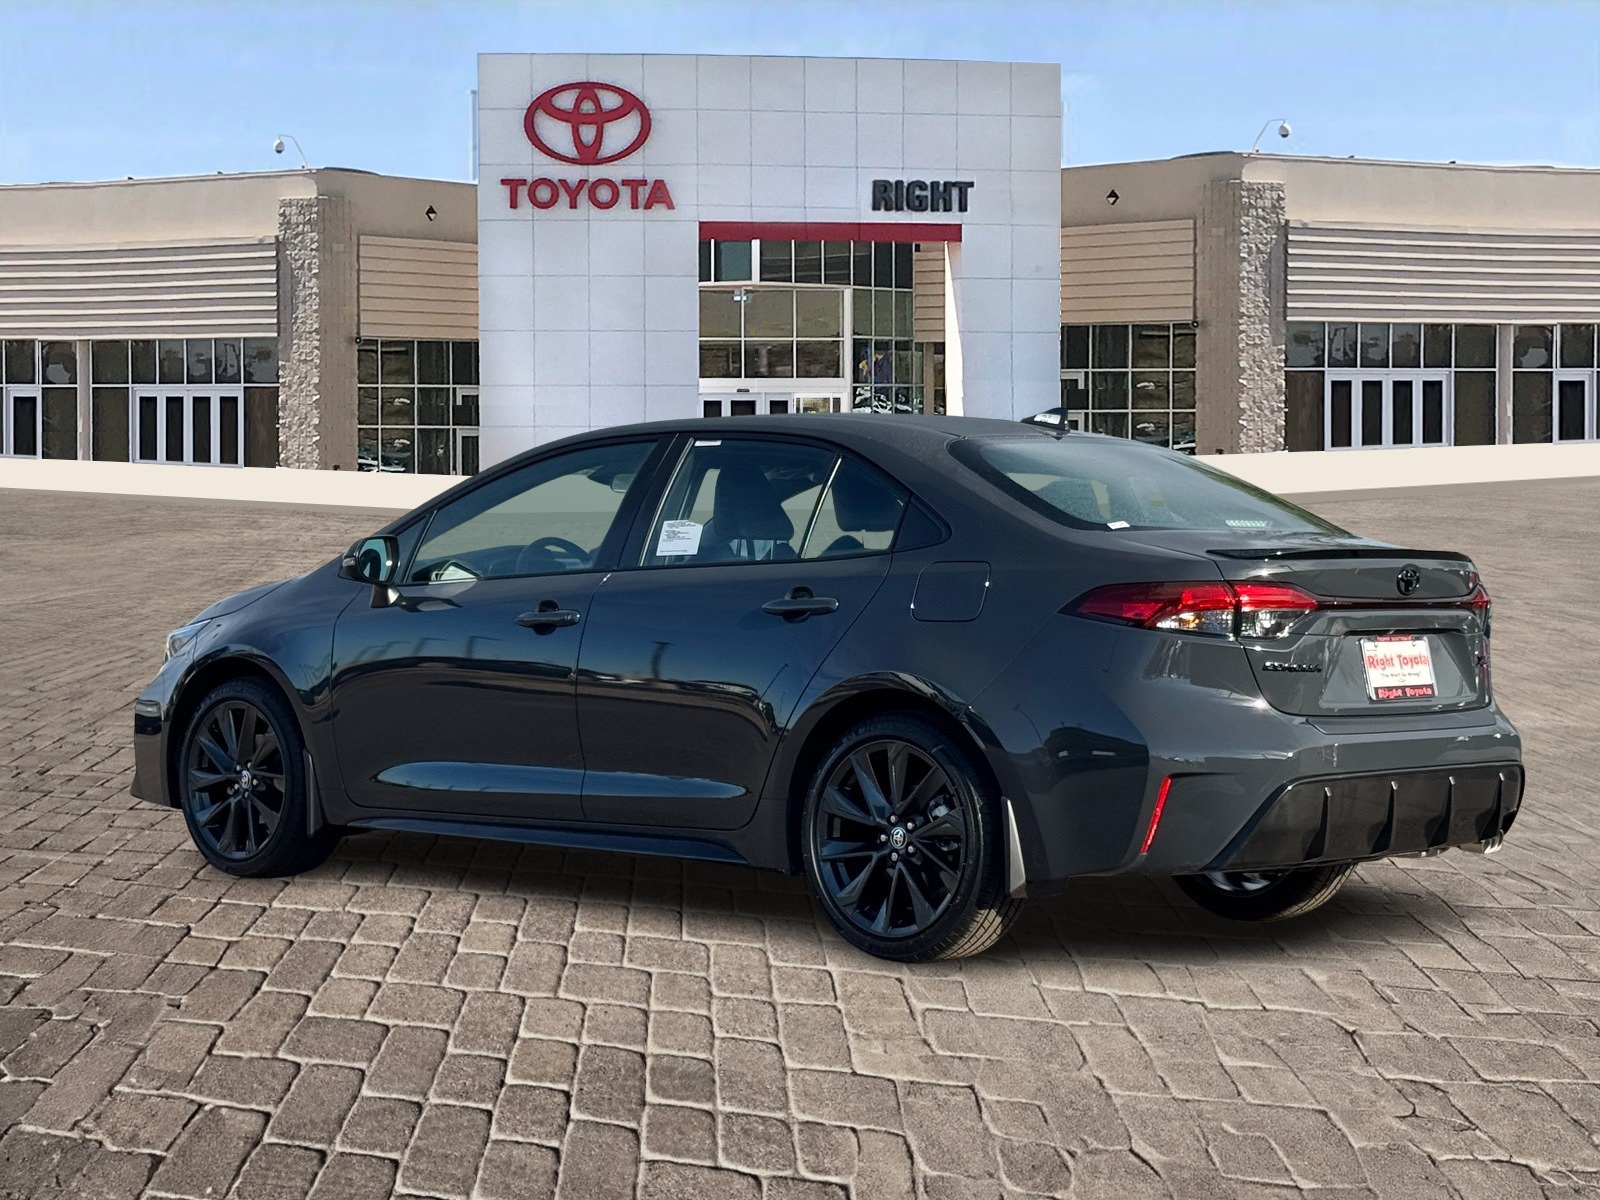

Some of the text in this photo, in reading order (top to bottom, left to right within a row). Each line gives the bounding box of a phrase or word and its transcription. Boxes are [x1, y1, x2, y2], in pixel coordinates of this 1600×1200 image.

[501, 178, 675, 210] TOYOTA
[872, 179, 975, 212] RIGHT
[1366, 654, 1428, 670] Right Toyota
[1378, 687, 1432, 698] Right Toyota
